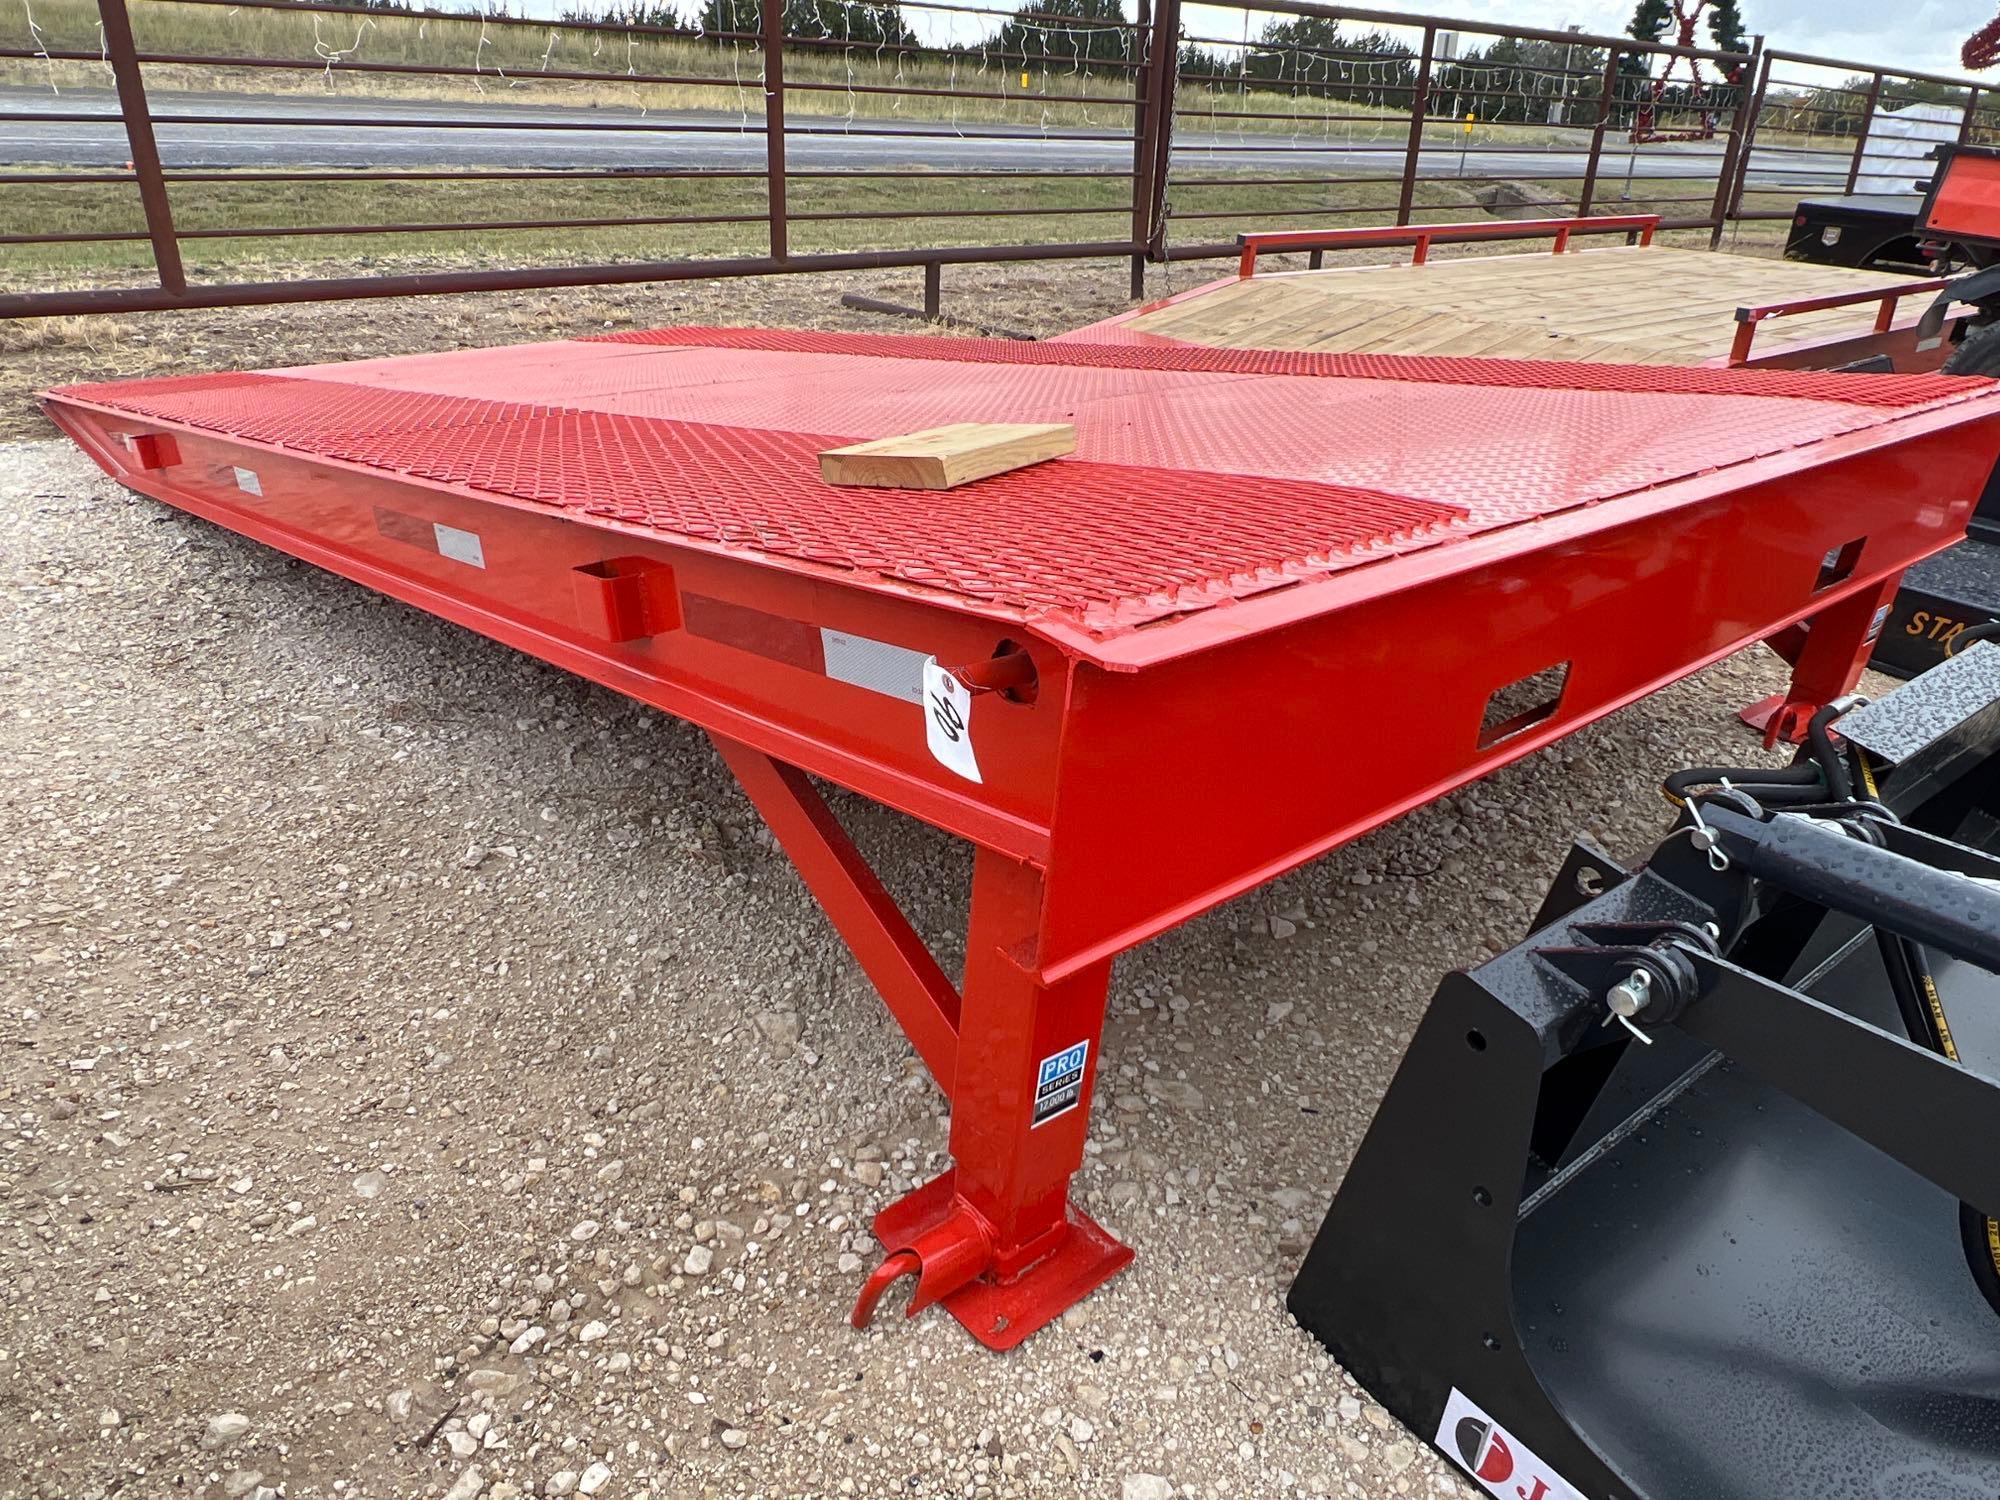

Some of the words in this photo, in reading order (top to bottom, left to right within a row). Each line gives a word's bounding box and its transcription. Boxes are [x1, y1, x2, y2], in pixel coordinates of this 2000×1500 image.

[1906, 611, 1972, 646] STA
[1044, 1049, 1081, 1080] PRO
[1042, 1071, 1078, 1095] SERIES
